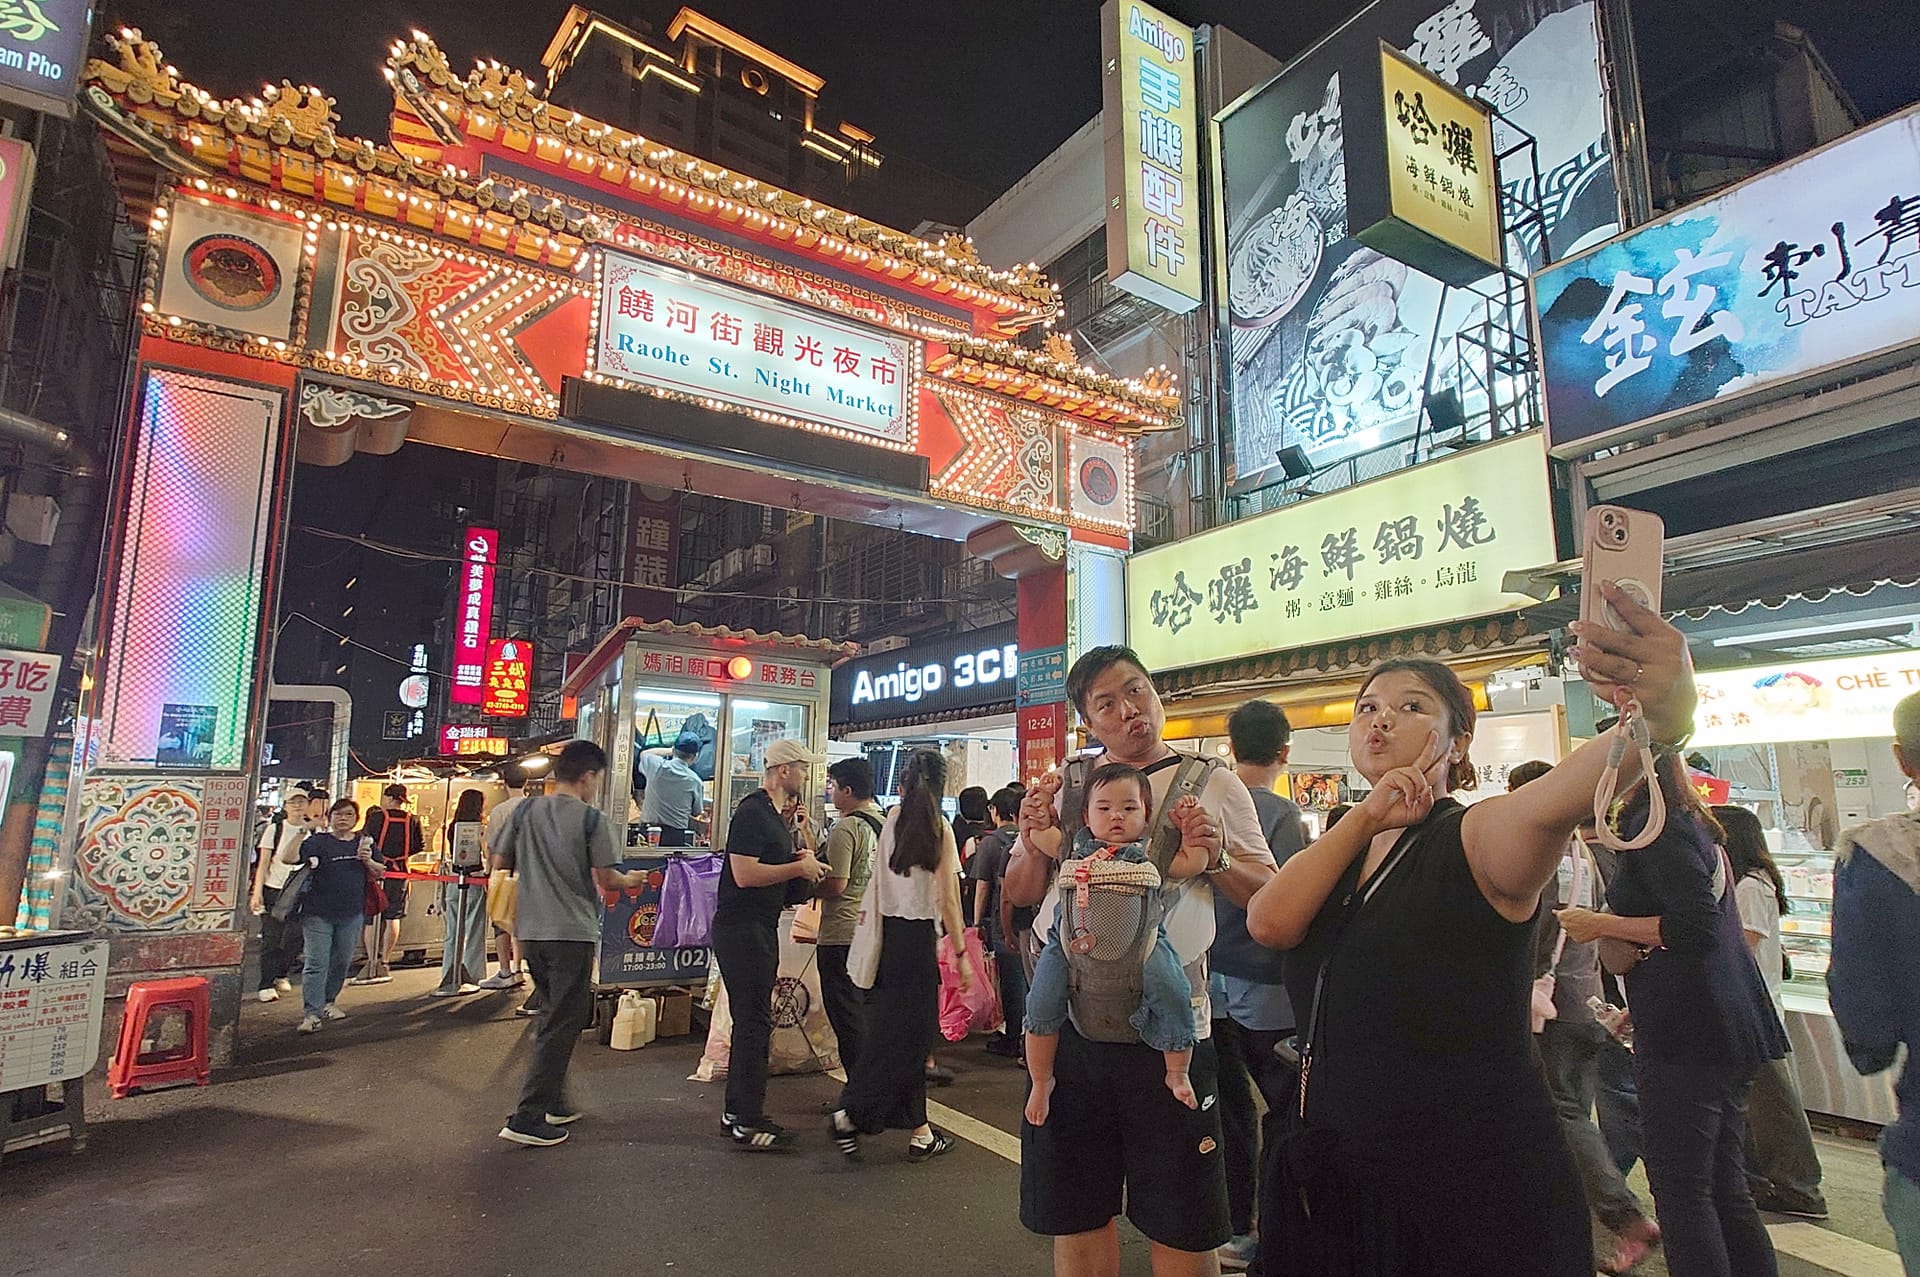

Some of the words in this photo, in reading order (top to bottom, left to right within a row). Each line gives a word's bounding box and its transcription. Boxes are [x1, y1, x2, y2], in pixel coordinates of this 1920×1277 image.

[1129, 6, 1185, 63] Amigo
[26, 51, 62, 80] Pho
[1139, 56, 1186, 277] 手機配件
[617, 284, 898, 387] 饒河街觀光夜市
[617, 331, 690, 367] Raohe
[708, 356, 739, 380] St.
[754, 367, 812, 397] Night
[826, 385, 896, 419] Market
[643, 652, 722, 679] 媽祖廟口
[760, 664, 816, 688] 服務台
[852, 662, 943, 702] Amigo
[1836, 666, 1891, 691] CHÈ
[206, 796, 243, 806] 24:00
[208, 782, 244, 791] 16:00
[200, 853, 231, 907] 禁止進入
[60, 958, 99, 980] 組合
